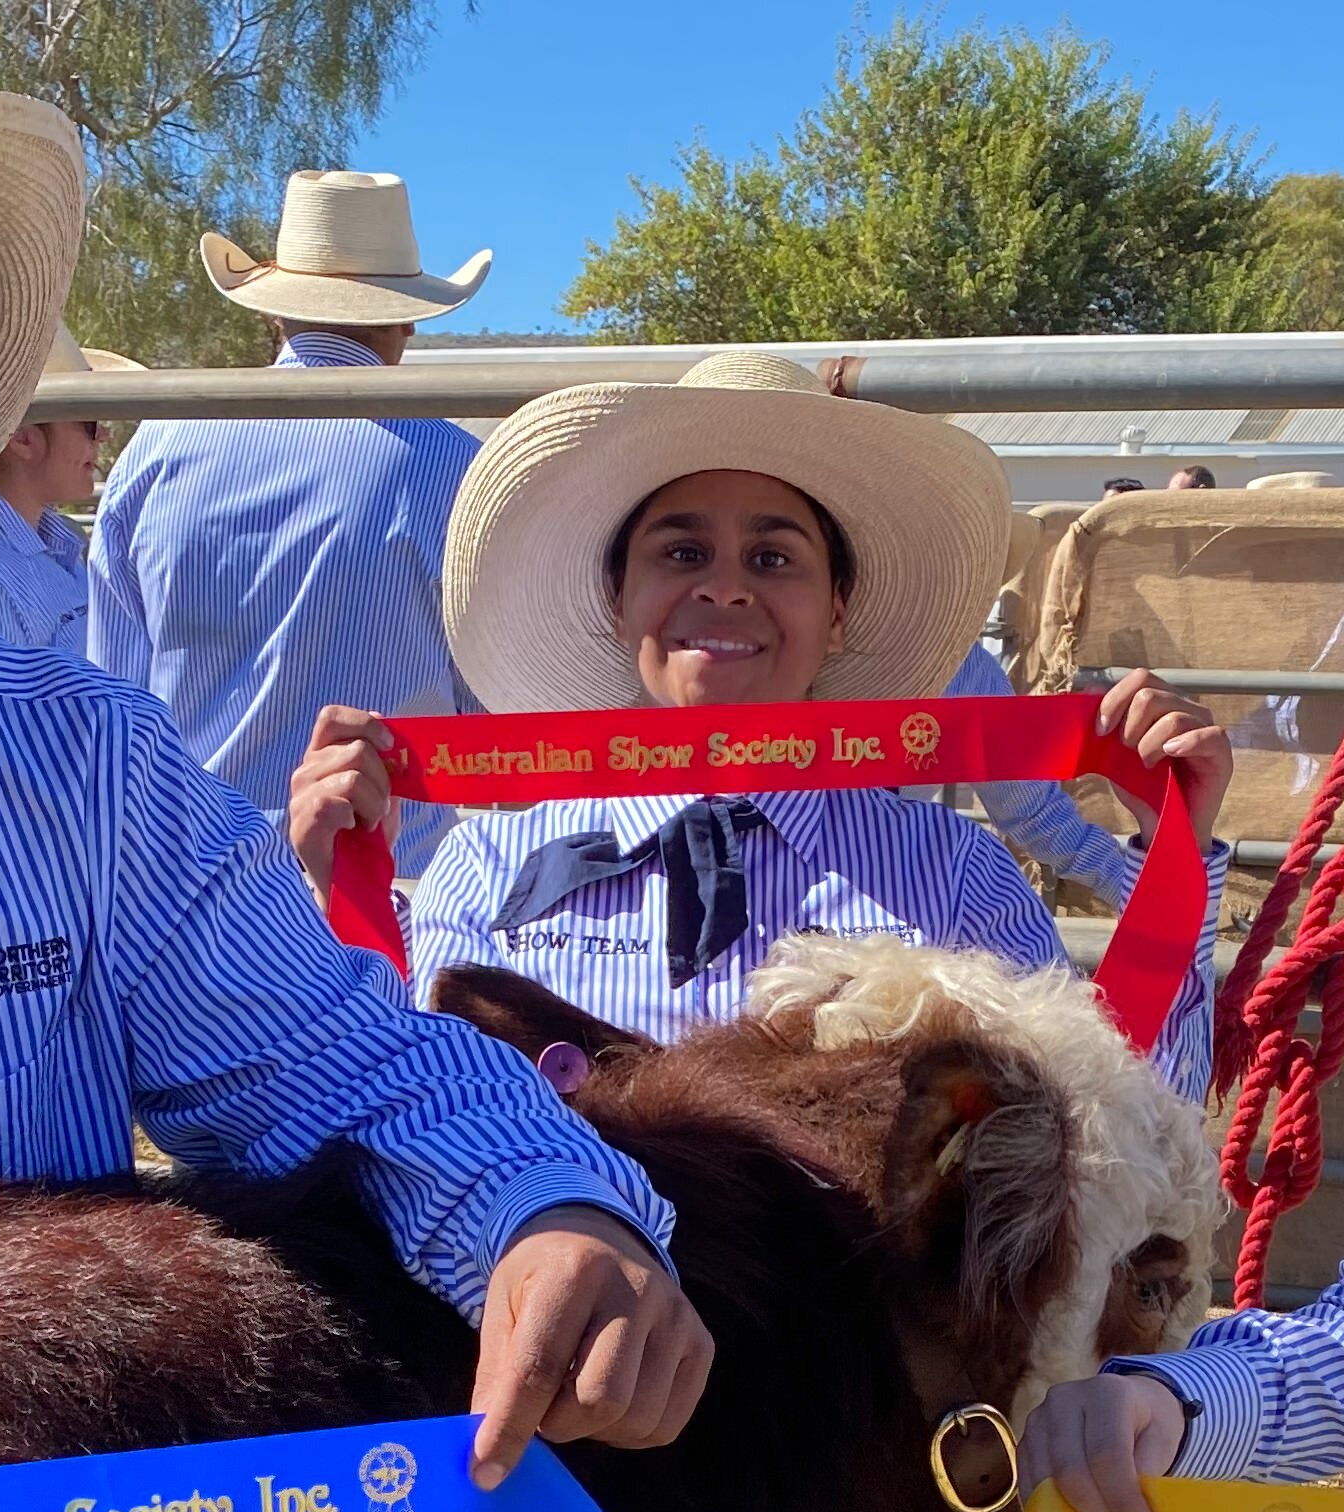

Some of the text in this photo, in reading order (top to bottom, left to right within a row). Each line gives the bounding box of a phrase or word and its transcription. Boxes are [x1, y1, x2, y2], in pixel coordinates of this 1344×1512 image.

[425, 740, 593, 776] Australian
[608, 736, 694, 776] Show
[707, 732, 816, 770] Society
[832, 727, 885, 768] Inc.
[506, 930, 650, 956] SHOW TEAM
